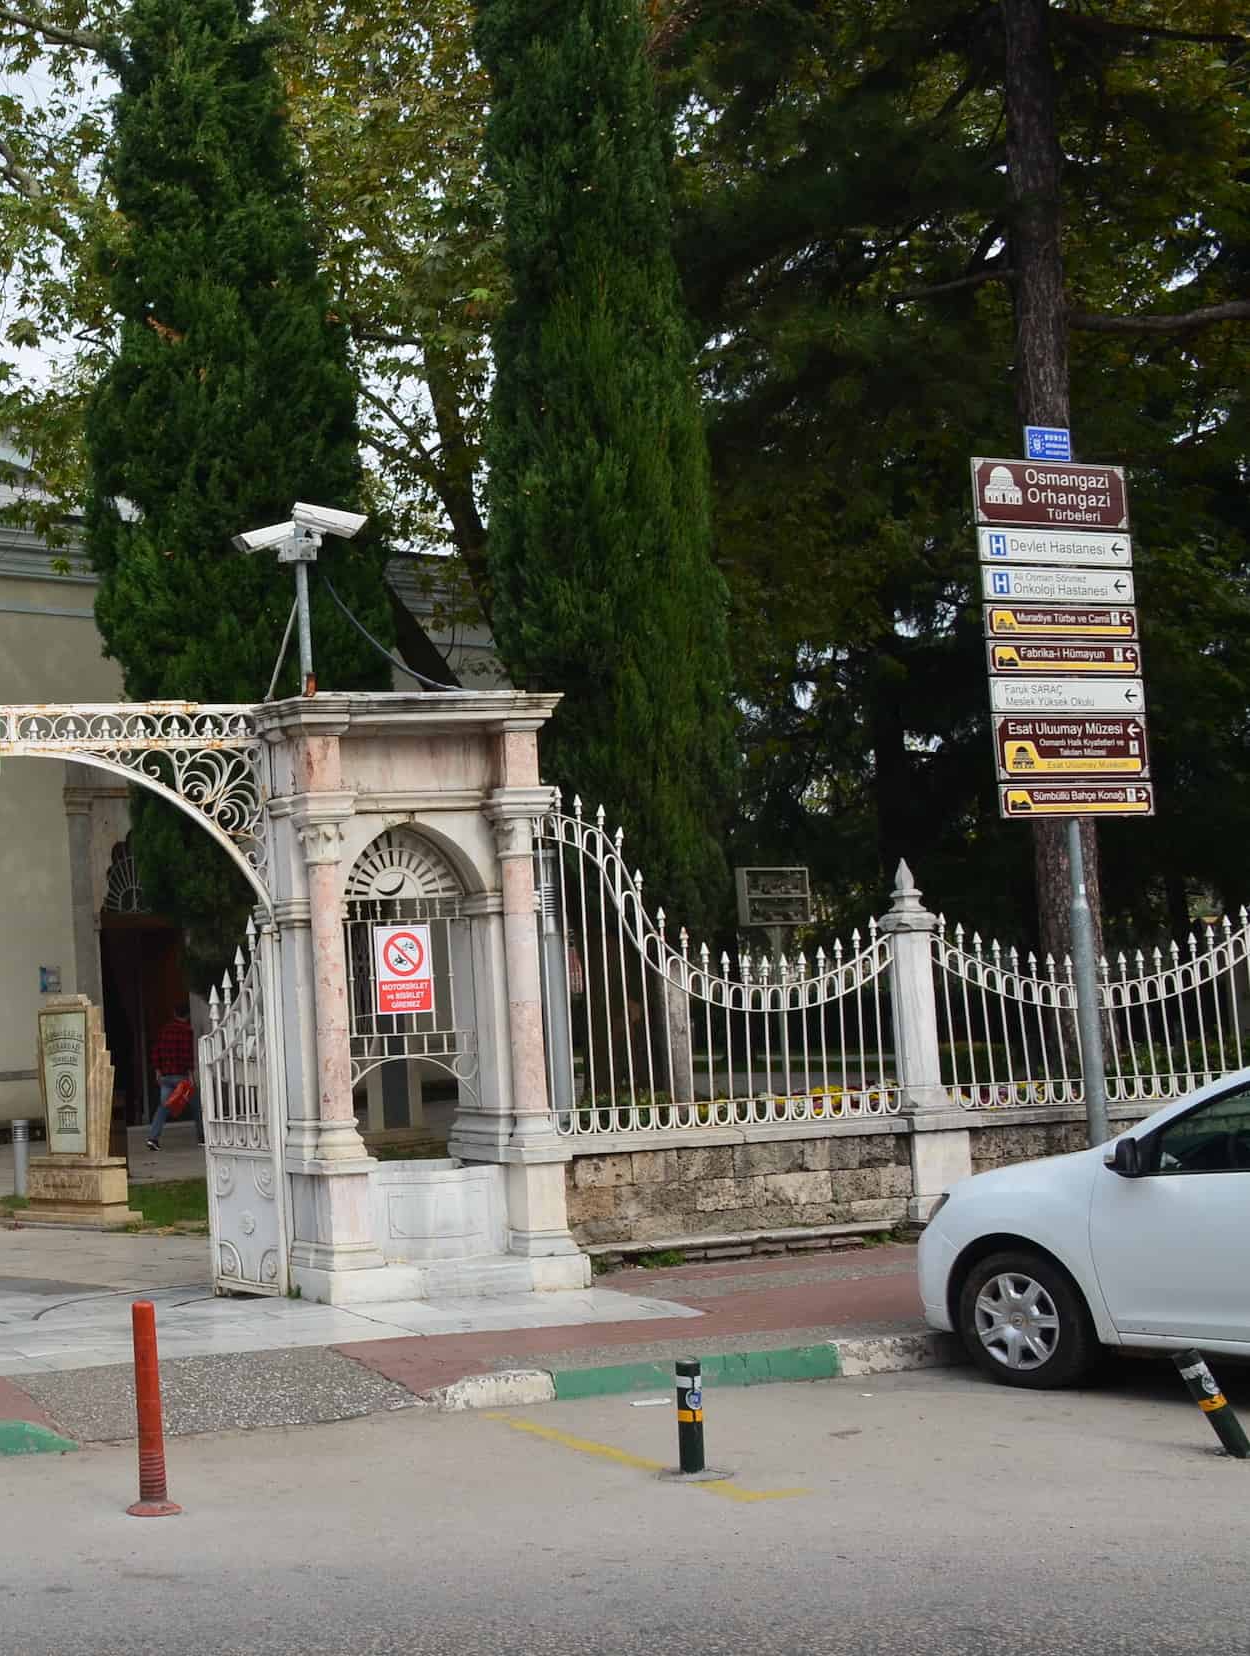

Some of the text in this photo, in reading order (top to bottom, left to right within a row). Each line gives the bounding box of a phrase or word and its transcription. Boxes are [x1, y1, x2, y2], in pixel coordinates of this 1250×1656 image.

[1025, 468, 1109, 491] Osmangazi
[1027, 488, 1111, 510] Orhangazi
[1046, 508, 1101, 522] Türbeleri
[991, 535, 1106, 556] H Devlet Hastanesi
[995, 574, 1008, 593] H
[1014, 582, 1108, 597] Onkoloji Hastanesi
[1076, 615, 1087, 623] ve
[1020, 646, 1060, 658] Fabrika-i
[1004, 684, 1029, 694] Faruk
[1008, 722, 1124, 737] Esat Uluumay Müzesi
